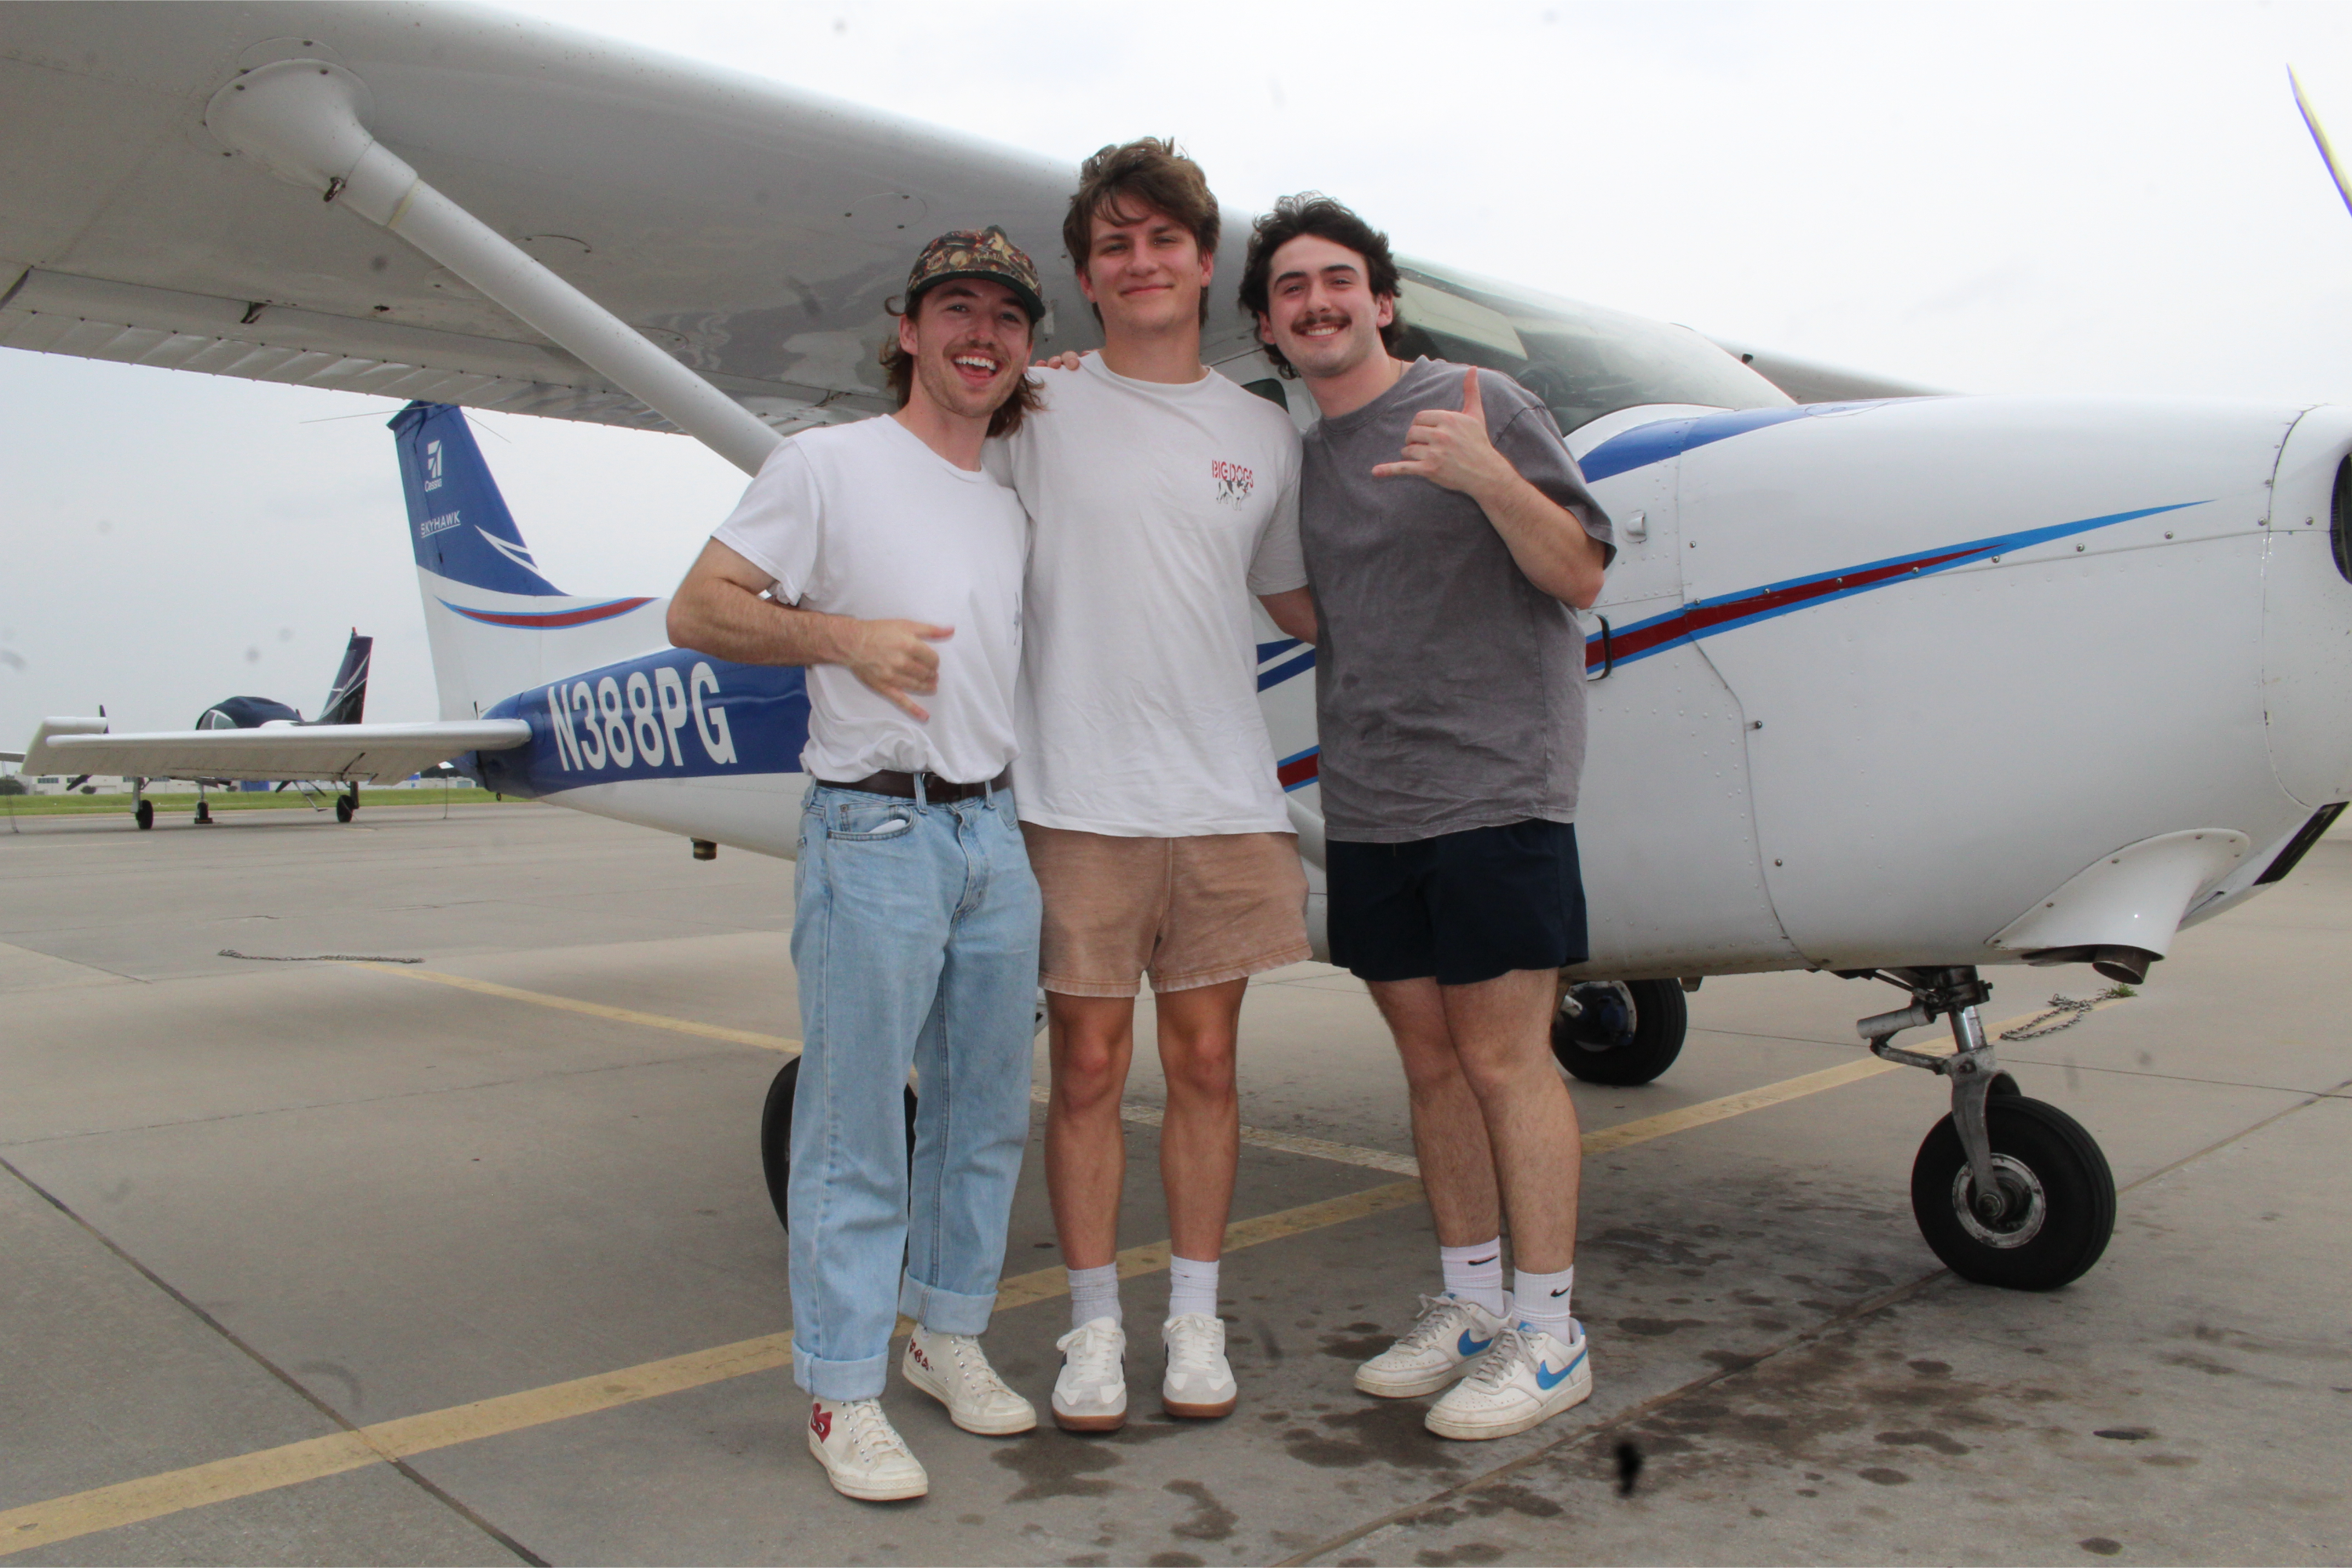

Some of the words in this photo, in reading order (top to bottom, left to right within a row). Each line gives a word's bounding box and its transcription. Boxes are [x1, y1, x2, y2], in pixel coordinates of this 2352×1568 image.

[425, 478, 442, 492] Cessna
[1212, 460, 1229, 480] BIG
[1229, 463, 1254, 488] DOGS
[421, 510, 461, 536] SKYHAWK
[548, 662, 738, 771] N388PG
